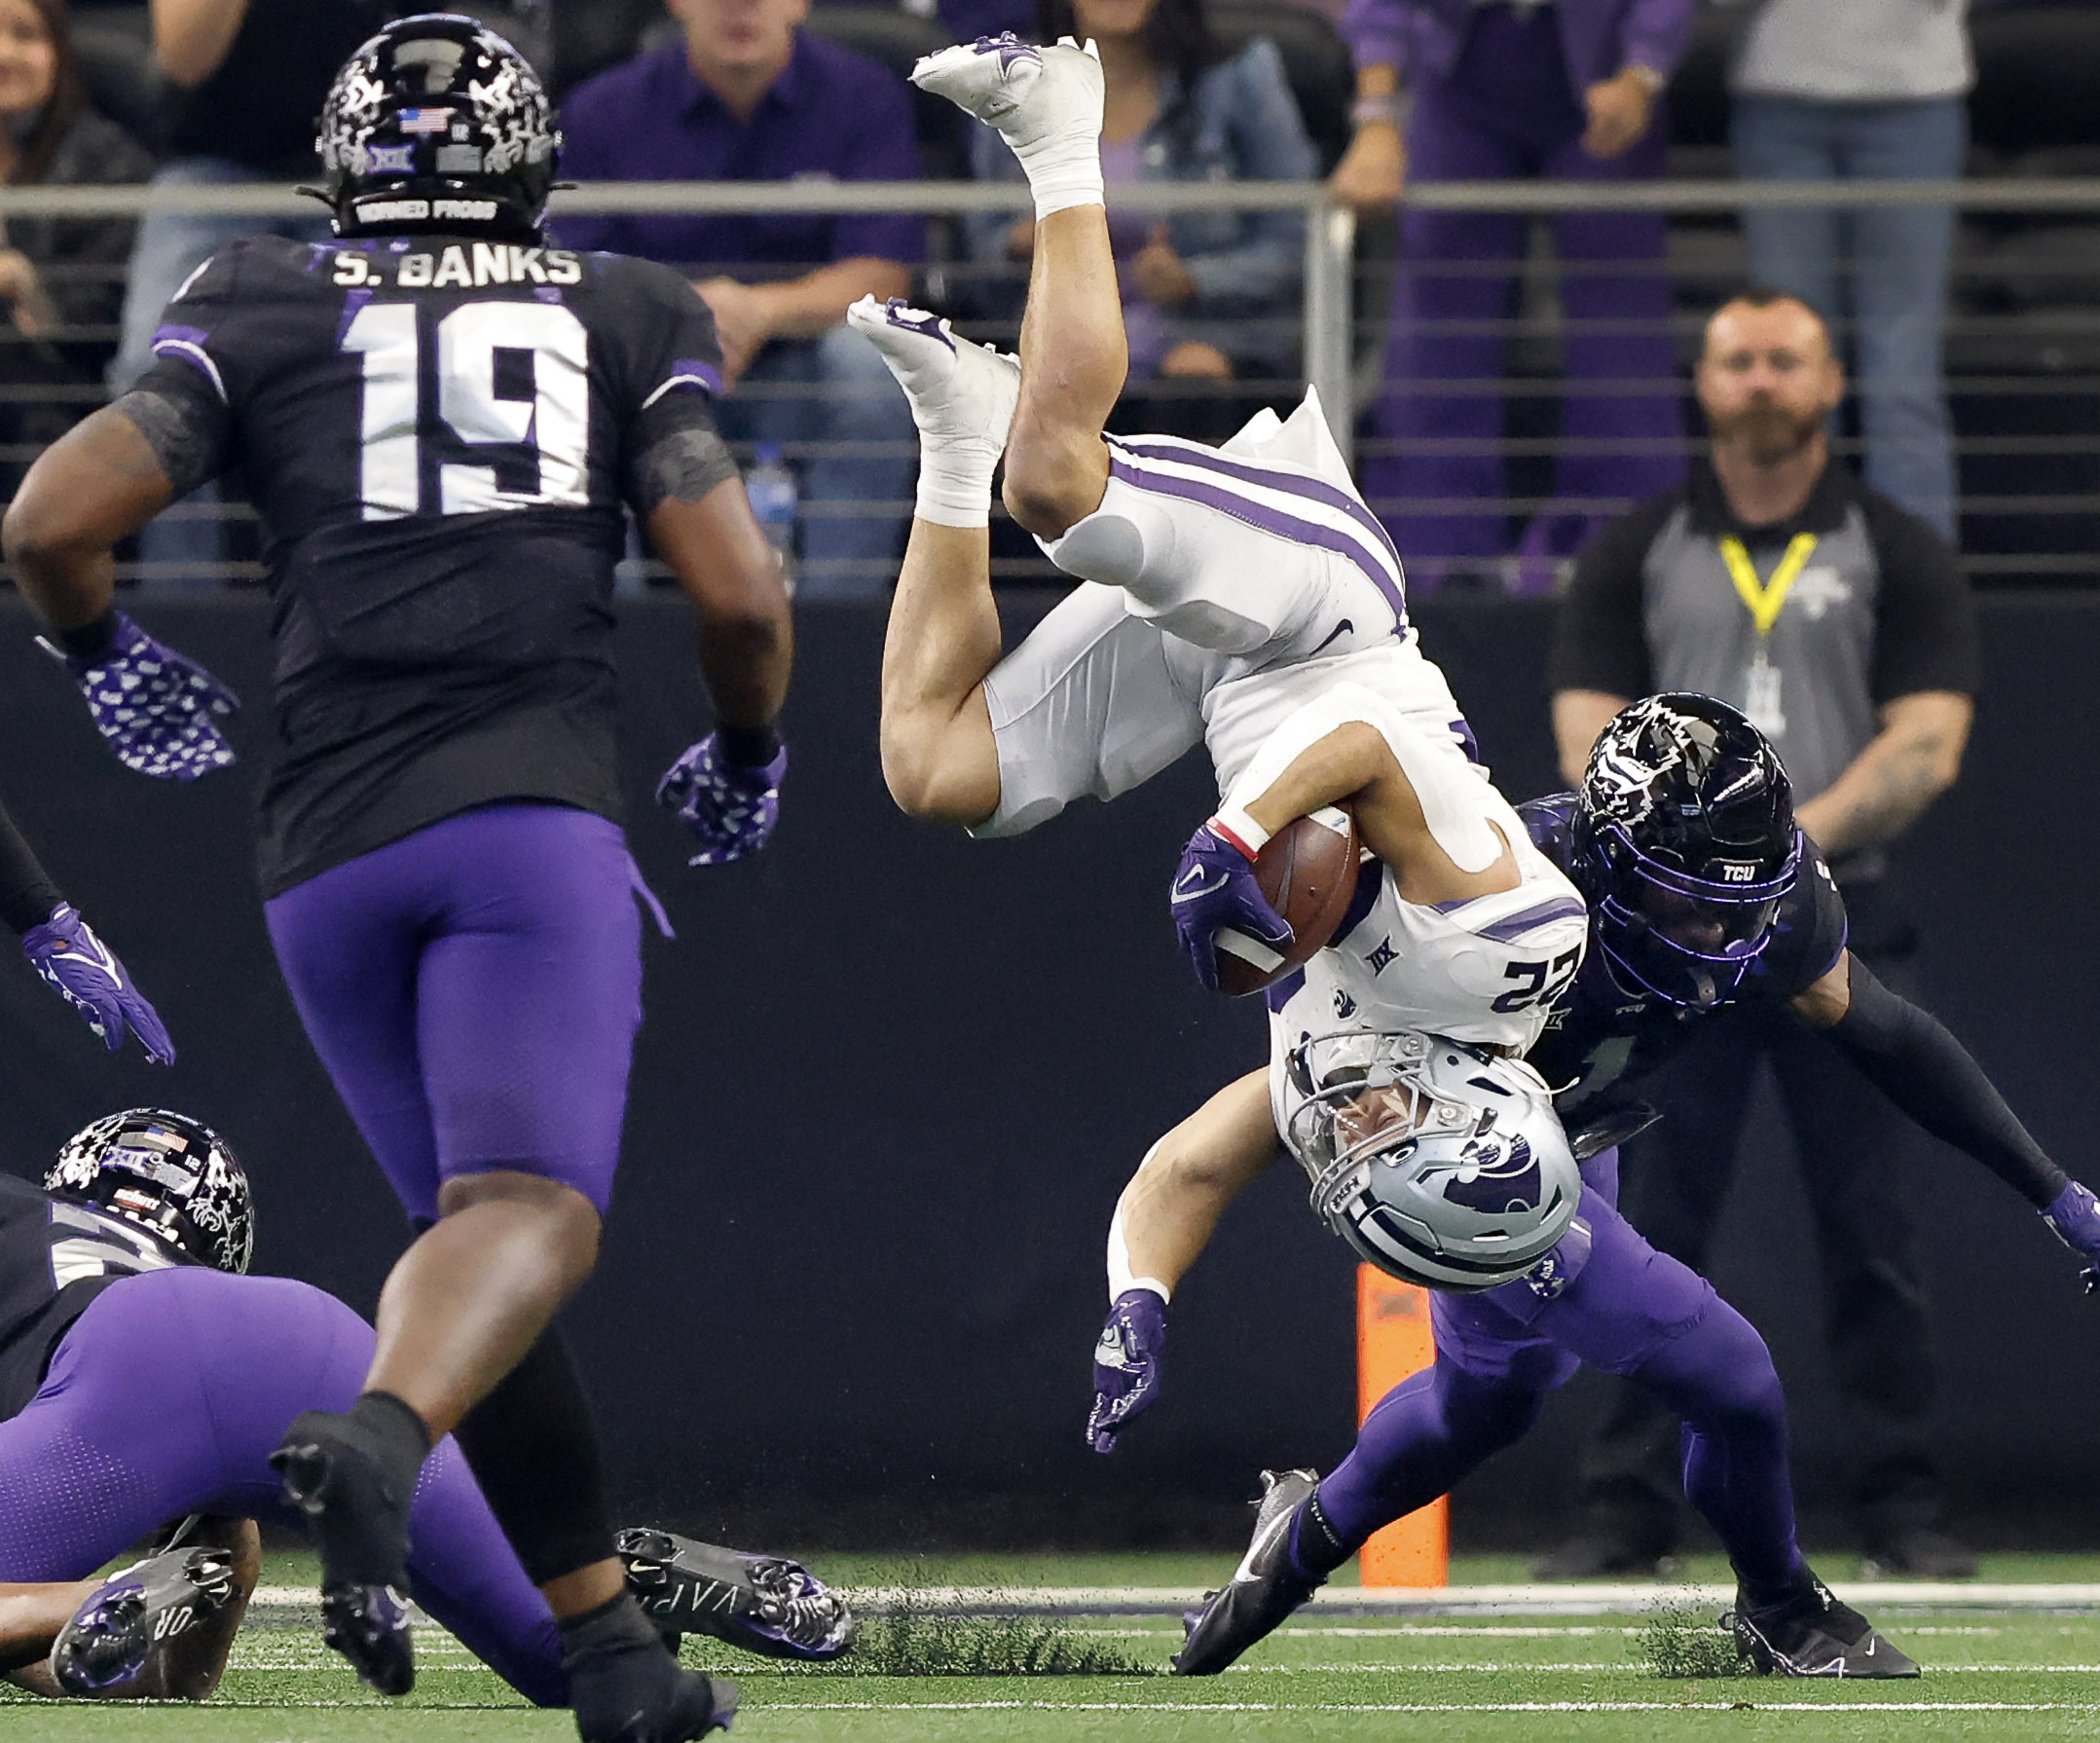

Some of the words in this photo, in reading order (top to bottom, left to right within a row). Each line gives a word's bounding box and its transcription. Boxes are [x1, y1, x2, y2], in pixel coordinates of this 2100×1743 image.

[333, 250, 383, 286] S.
[397, 242, 582, 287] BANKS
[342, 301, 590, 523] 19
[1723, 865, 1755, 881] TCU
[1490, 941, 1582, 1014] 22
[184, 1154, 201, 1171] 12
[154, 1606, 197, 1641] OR
